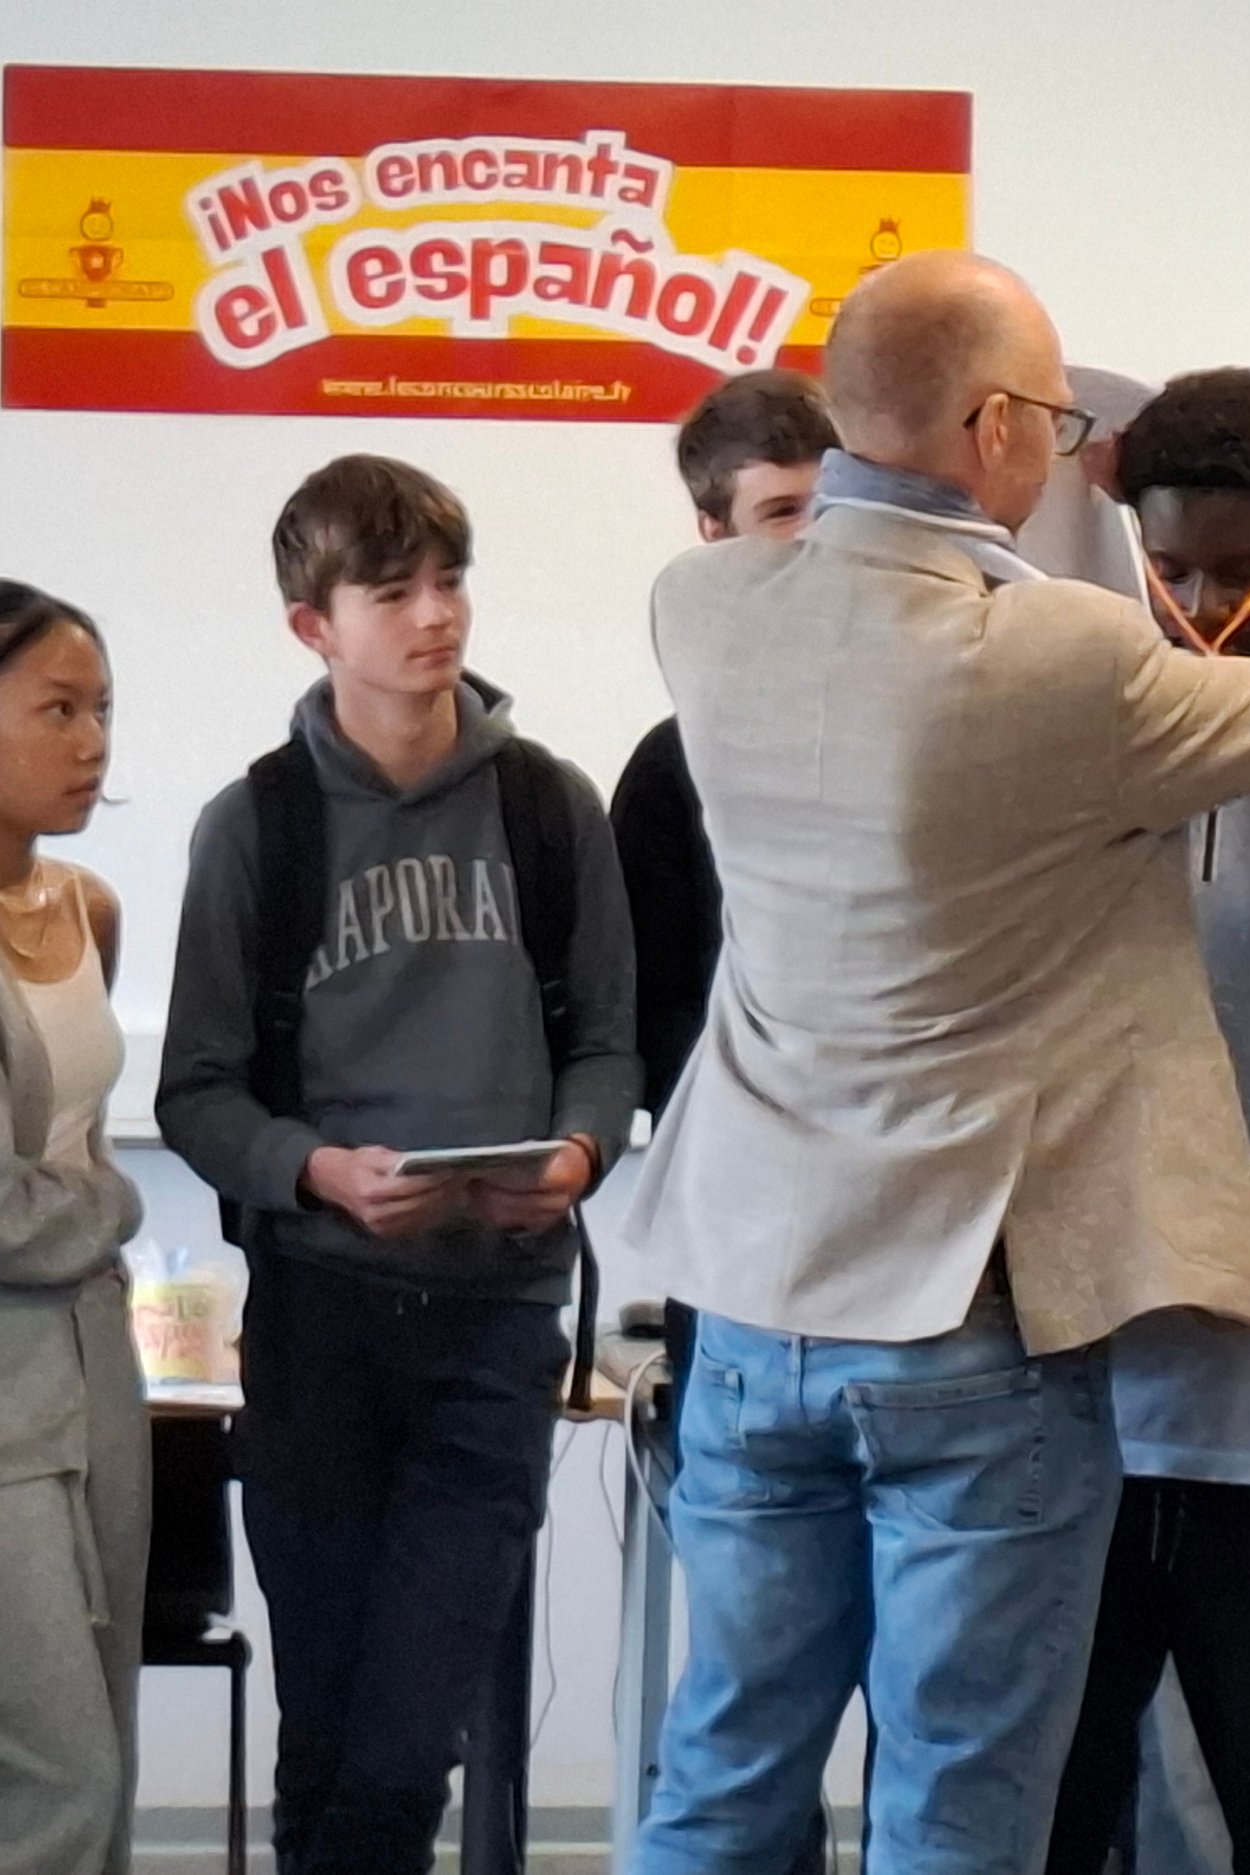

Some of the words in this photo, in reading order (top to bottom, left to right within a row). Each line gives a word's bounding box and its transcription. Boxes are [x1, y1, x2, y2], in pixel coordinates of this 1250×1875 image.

[375, 143, 660, 208] encanta
[213, 244, 308, 350] el
[346, 228, 790, 366] español!
